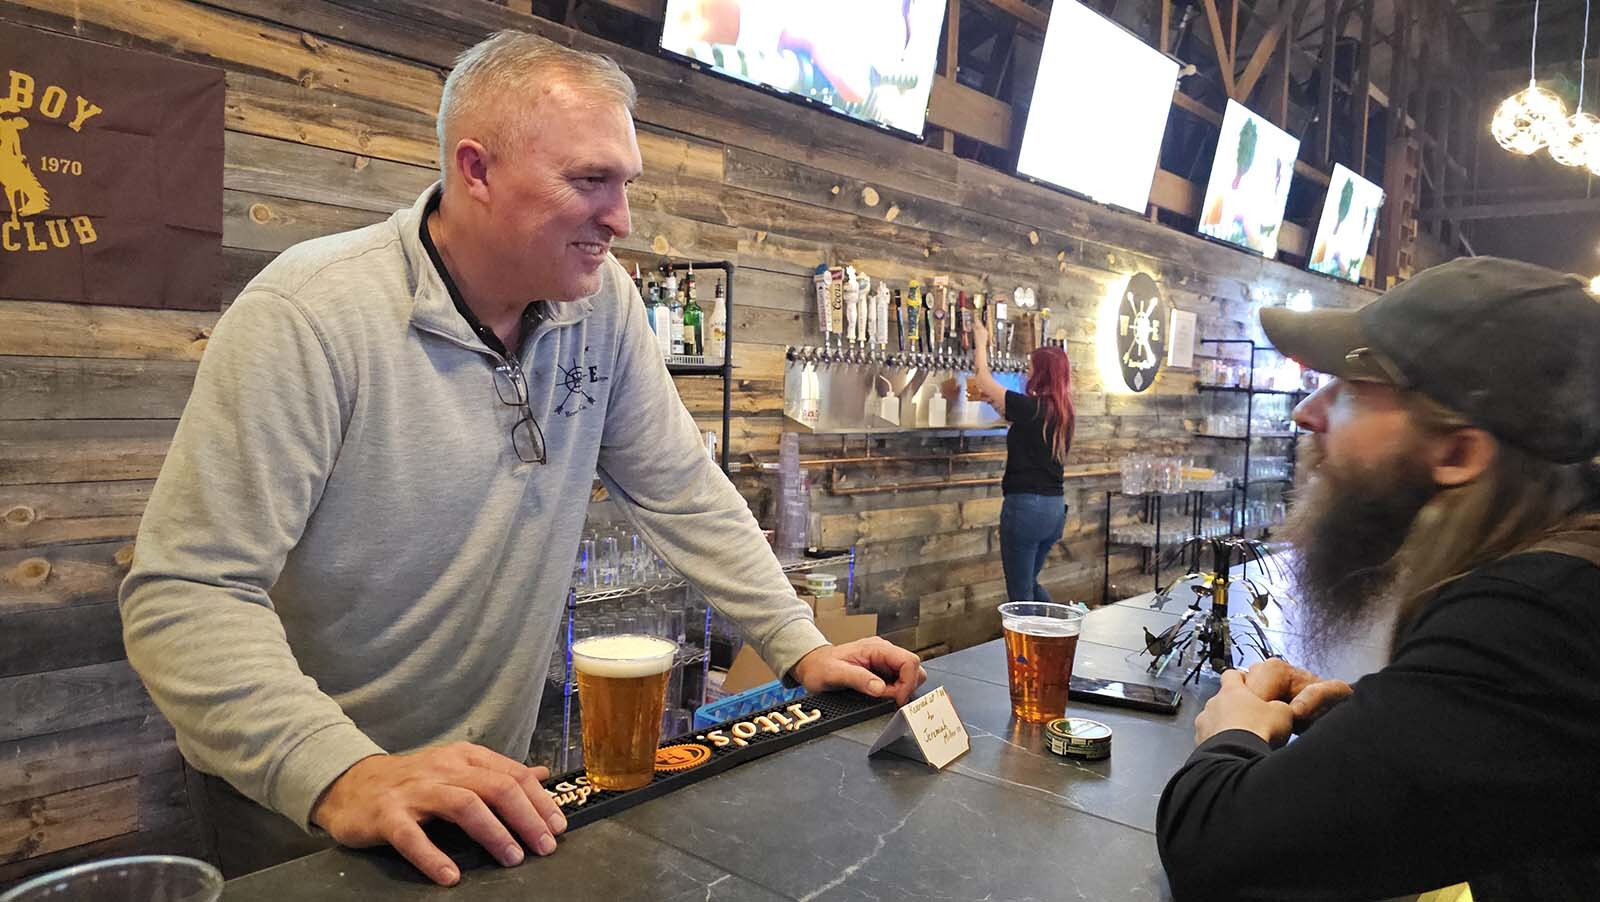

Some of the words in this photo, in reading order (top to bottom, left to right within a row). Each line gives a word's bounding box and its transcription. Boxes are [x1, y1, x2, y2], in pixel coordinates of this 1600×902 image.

[41, 156, 82, 176] 1970
[2, 215, 97, 251] CLUB
[832, 283, 842, 311] Coors
[706, 703, 822, 747] Tito's
